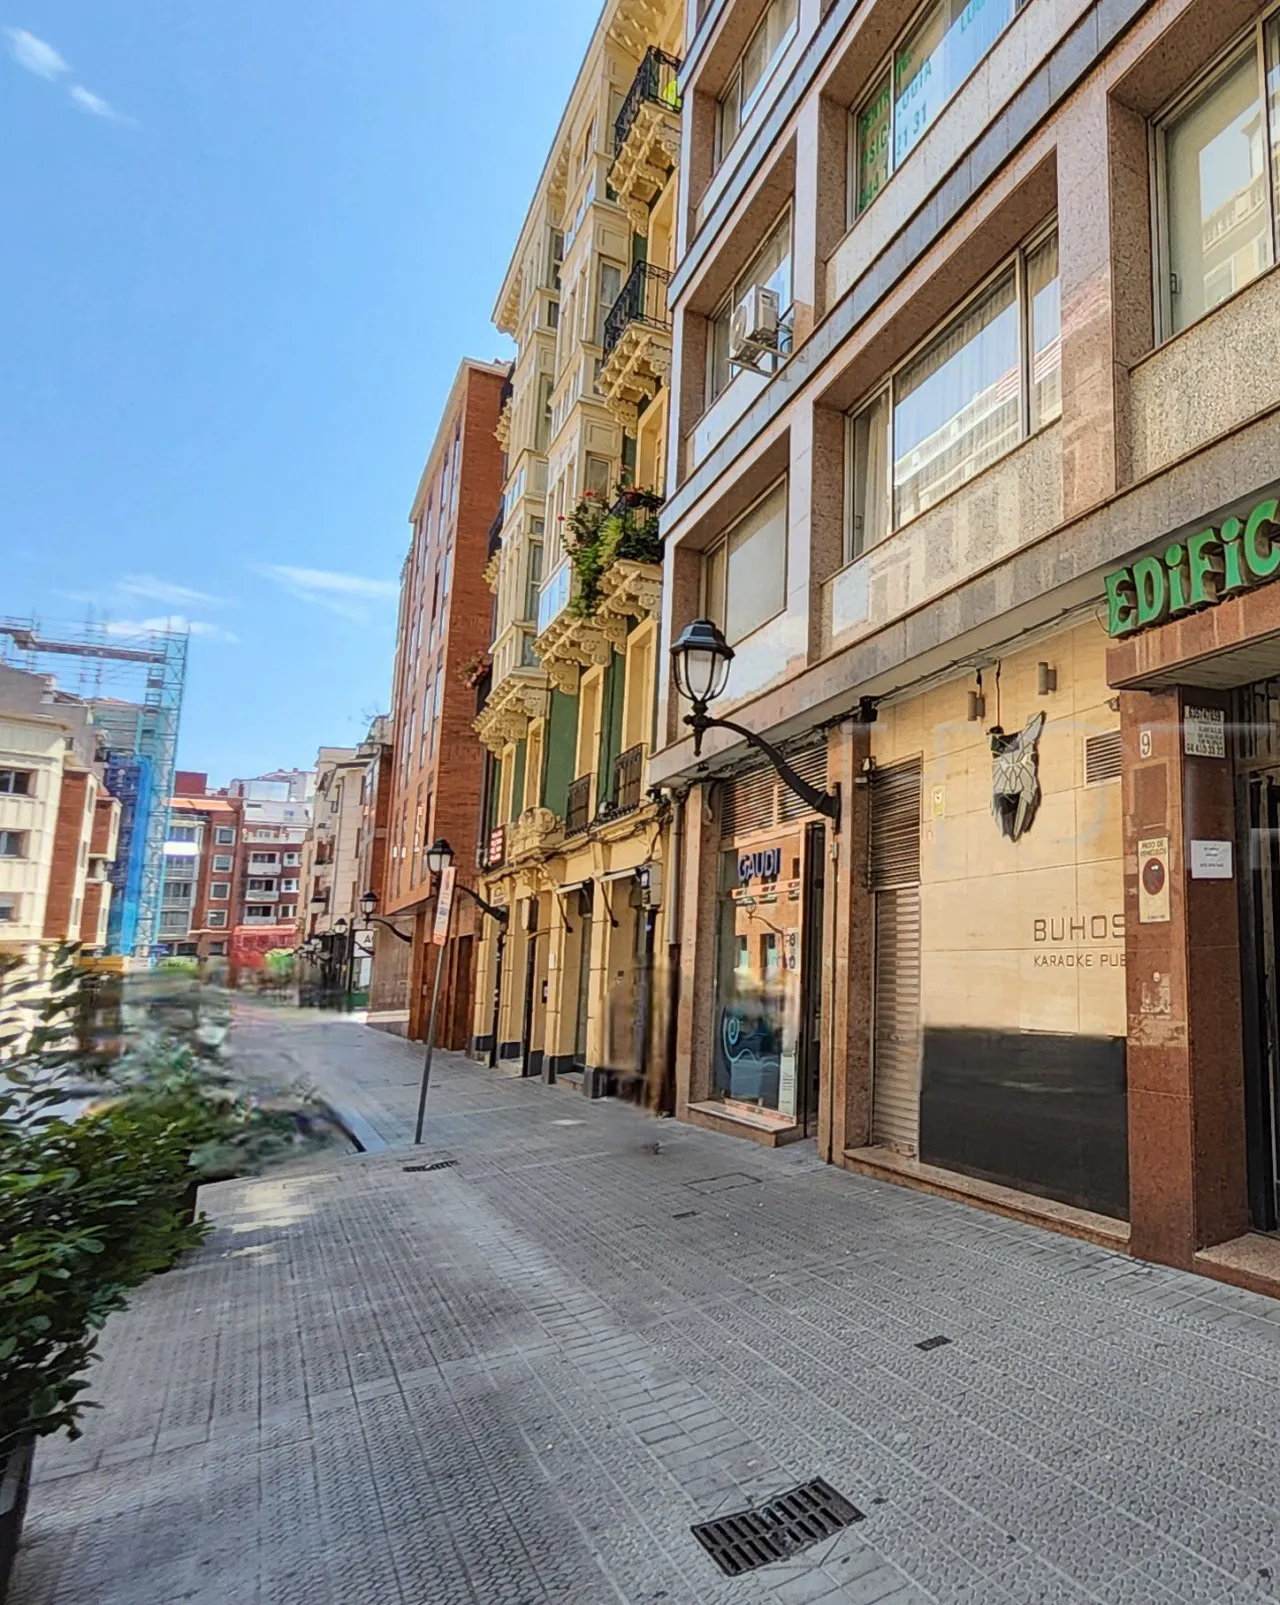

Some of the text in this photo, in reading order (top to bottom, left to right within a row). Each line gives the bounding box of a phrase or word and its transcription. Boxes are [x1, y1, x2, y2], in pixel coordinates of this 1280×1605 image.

[1141, 733, 1151, 756] 9
[738, 848, 782, 881] GAUDI
[1034, 913, 1126, 942] BUHOS
[1034, 954, 1093, 968] KARAOKE
